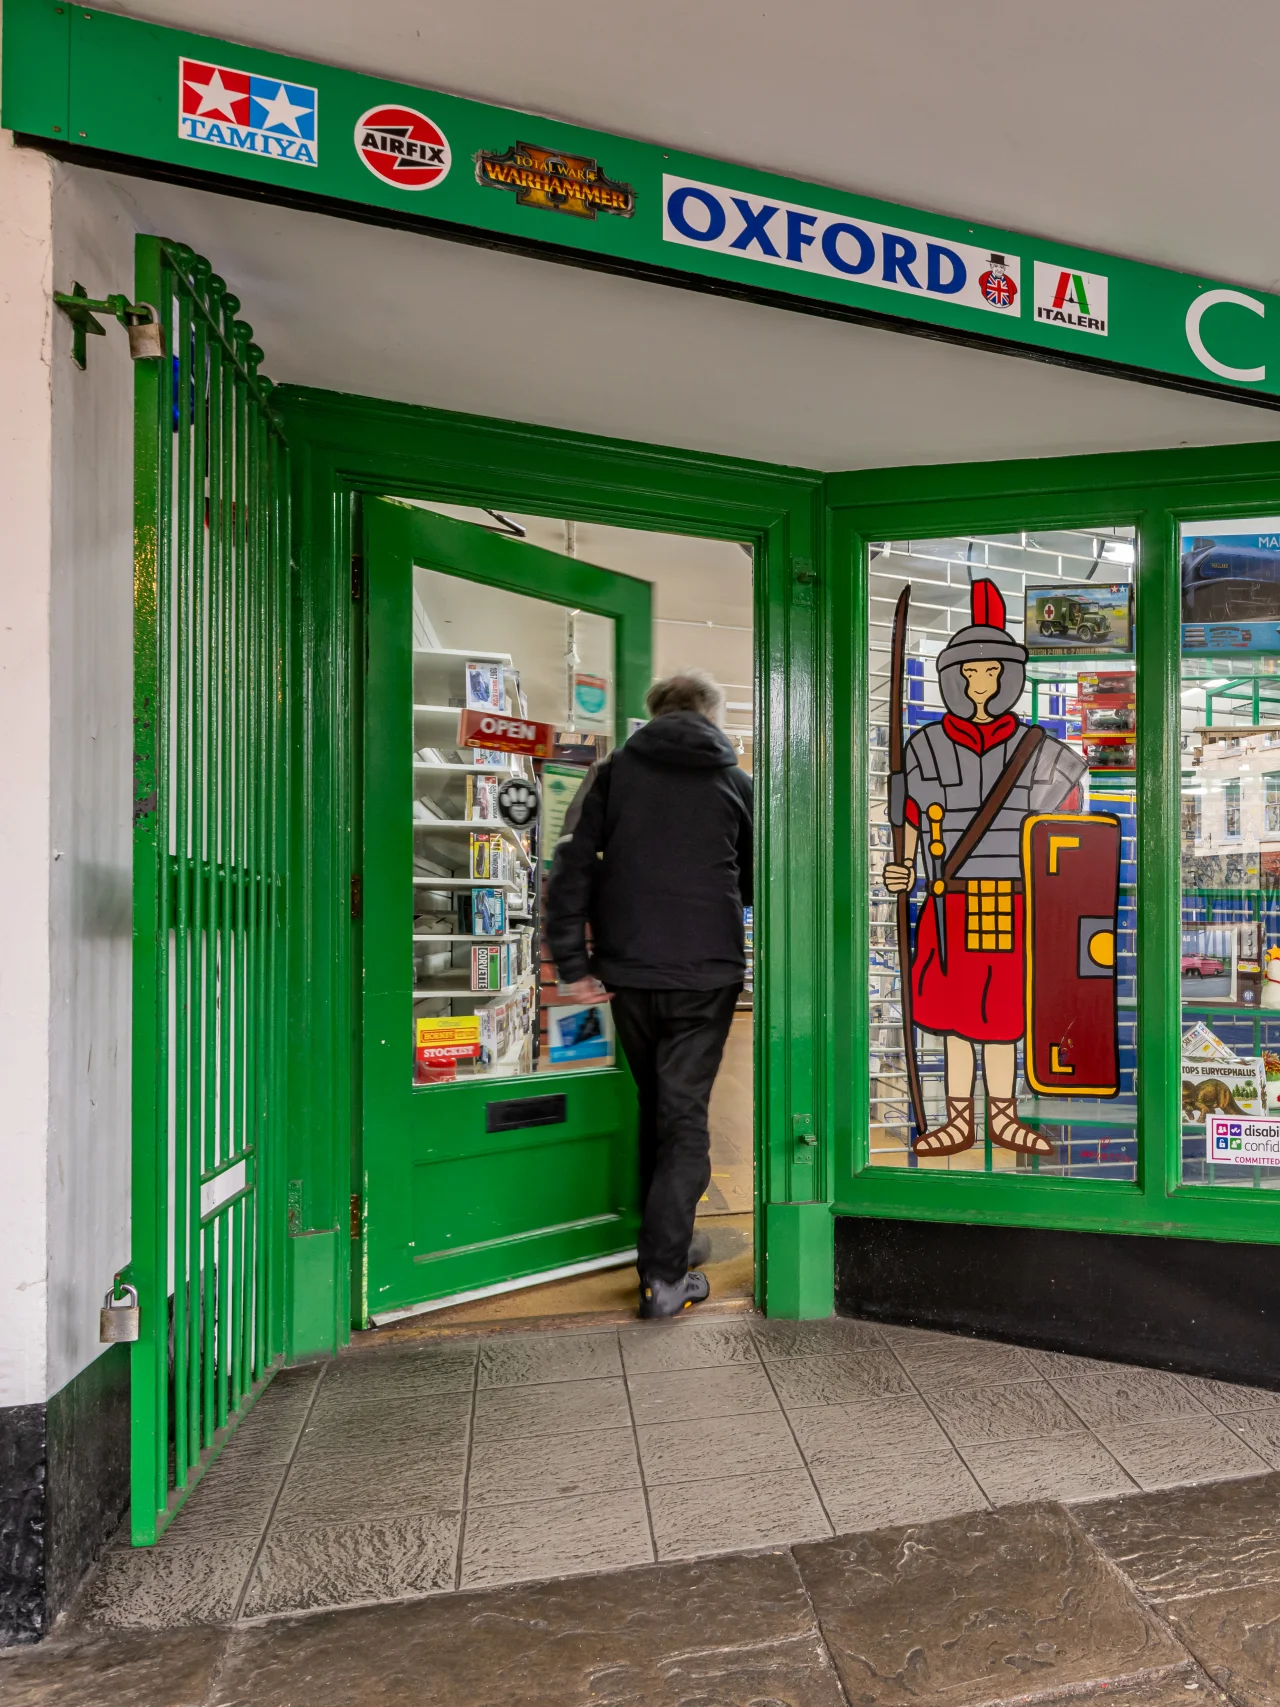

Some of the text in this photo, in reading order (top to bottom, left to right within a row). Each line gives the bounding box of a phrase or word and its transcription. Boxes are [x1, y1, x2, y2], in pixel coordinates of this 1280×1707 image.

[182, 117, 317, 164] TAMIYA
[360, 132, 446, 165] AIRFIX
[516, 155, 586, 180] TOTAL WAR
[484, 161, 627, 209] WARHAMMER
[667, 187, 967, 295] OXFORD
[1037, 306, 1106, 332] ITALERI
[480, 717, 537, 740] OPEN
[478, 949, 488, 990] CORVETTE
[424, 1045, 475, 1058] STOCKIST
[1201, 1067, 1257, 1077] EURYCEPHALUS
[1234, 1156, 1280, 1165] COMMITTED
